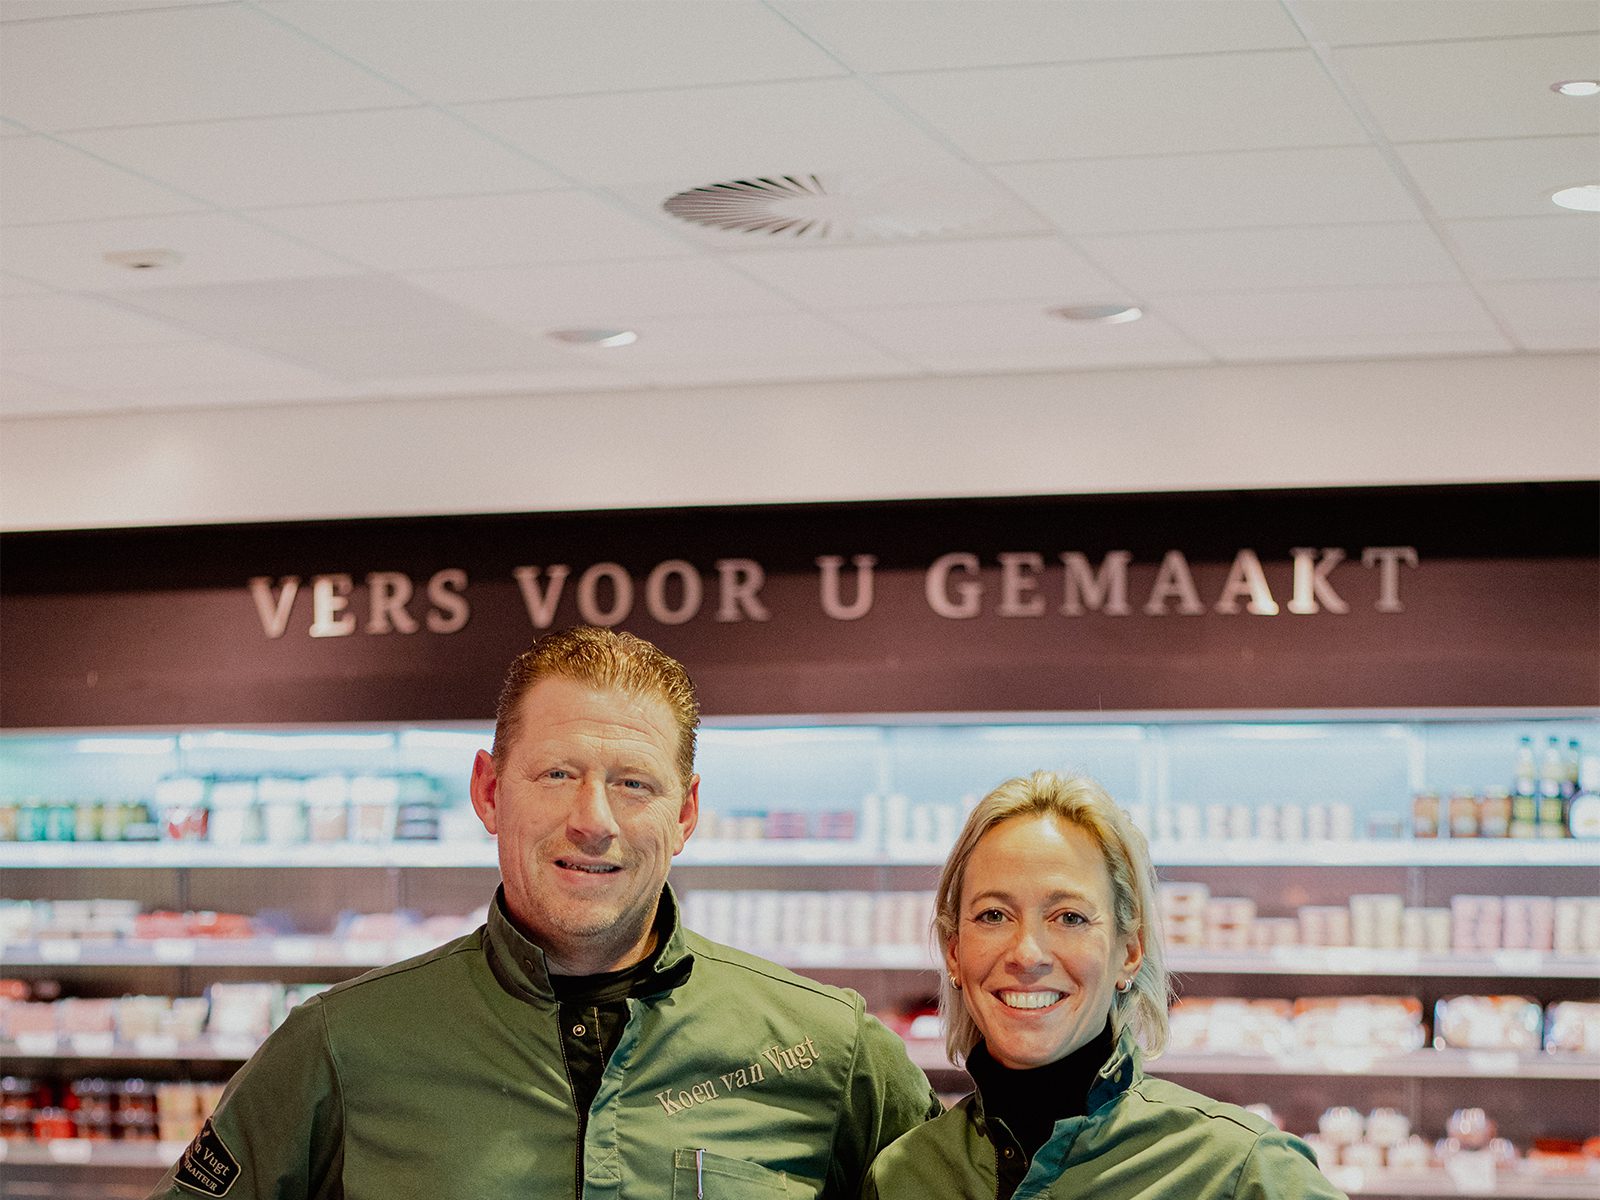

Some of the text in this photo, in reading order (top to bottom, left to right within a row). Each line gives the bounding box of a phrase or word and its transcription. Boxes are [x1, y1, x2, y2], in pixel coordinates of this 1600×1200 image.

[248, 546, 1420, 639] VERS VOOR U GEMAAKT
[655, 1035, 820, 1117] Koen van Vugt
[203, 1147, 230, 1176] Vugt
